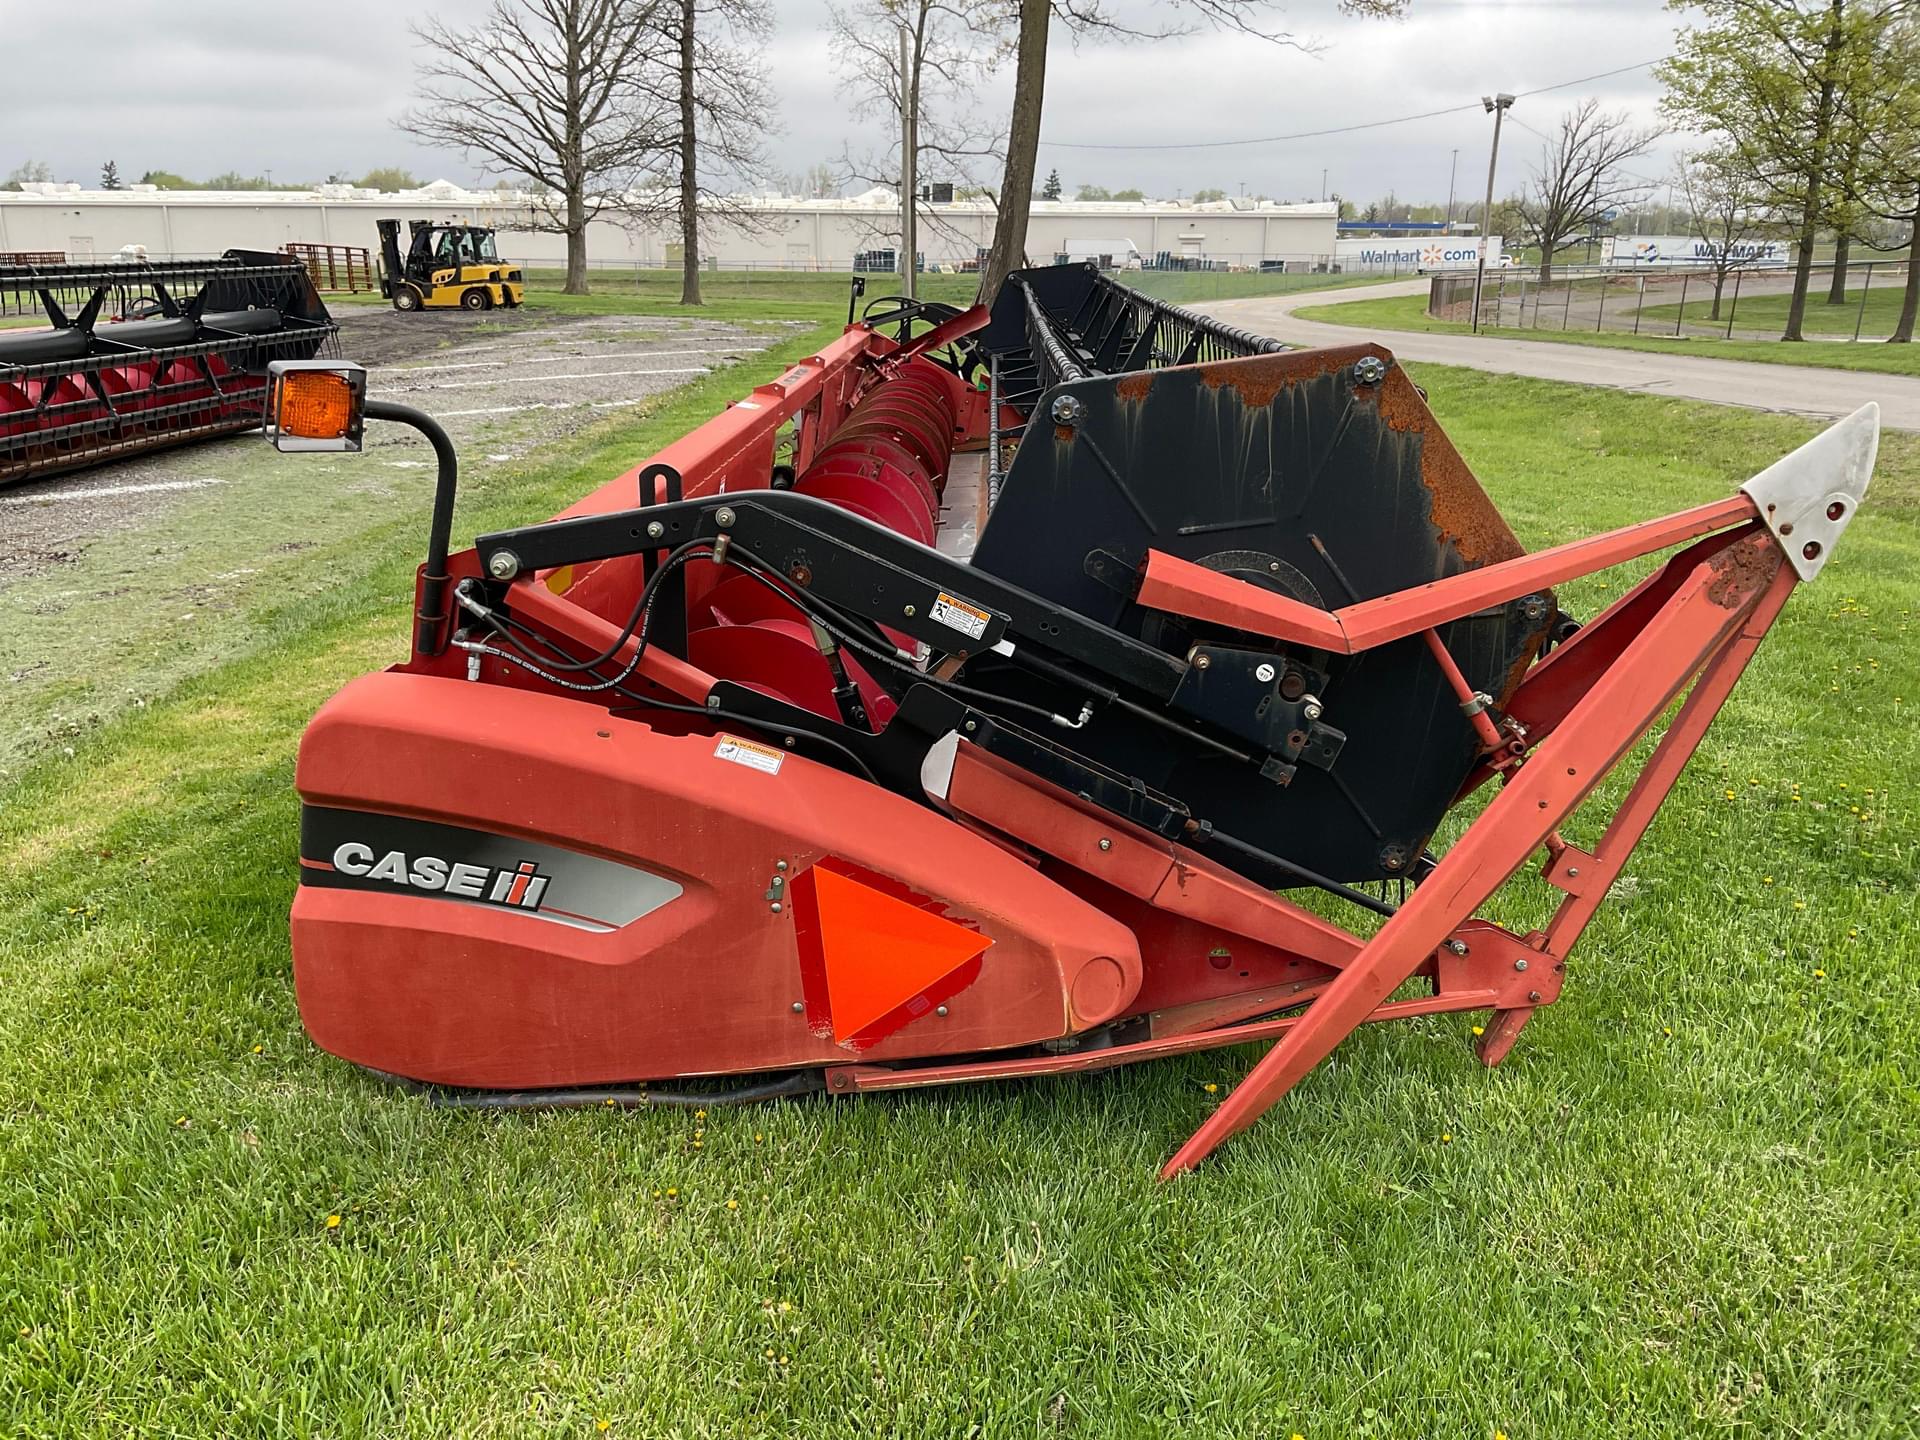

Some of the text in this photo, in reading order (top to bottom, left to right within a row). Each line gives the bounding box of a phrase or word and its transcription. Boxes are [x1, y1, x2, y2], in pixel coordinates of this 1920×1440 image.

[1360, 249, 1421, 264] Walmart
[953, 601, 981, 617] WARNING
[739, 743, 778, 757] WARNING
[333, 842, 491, 898] CASE
